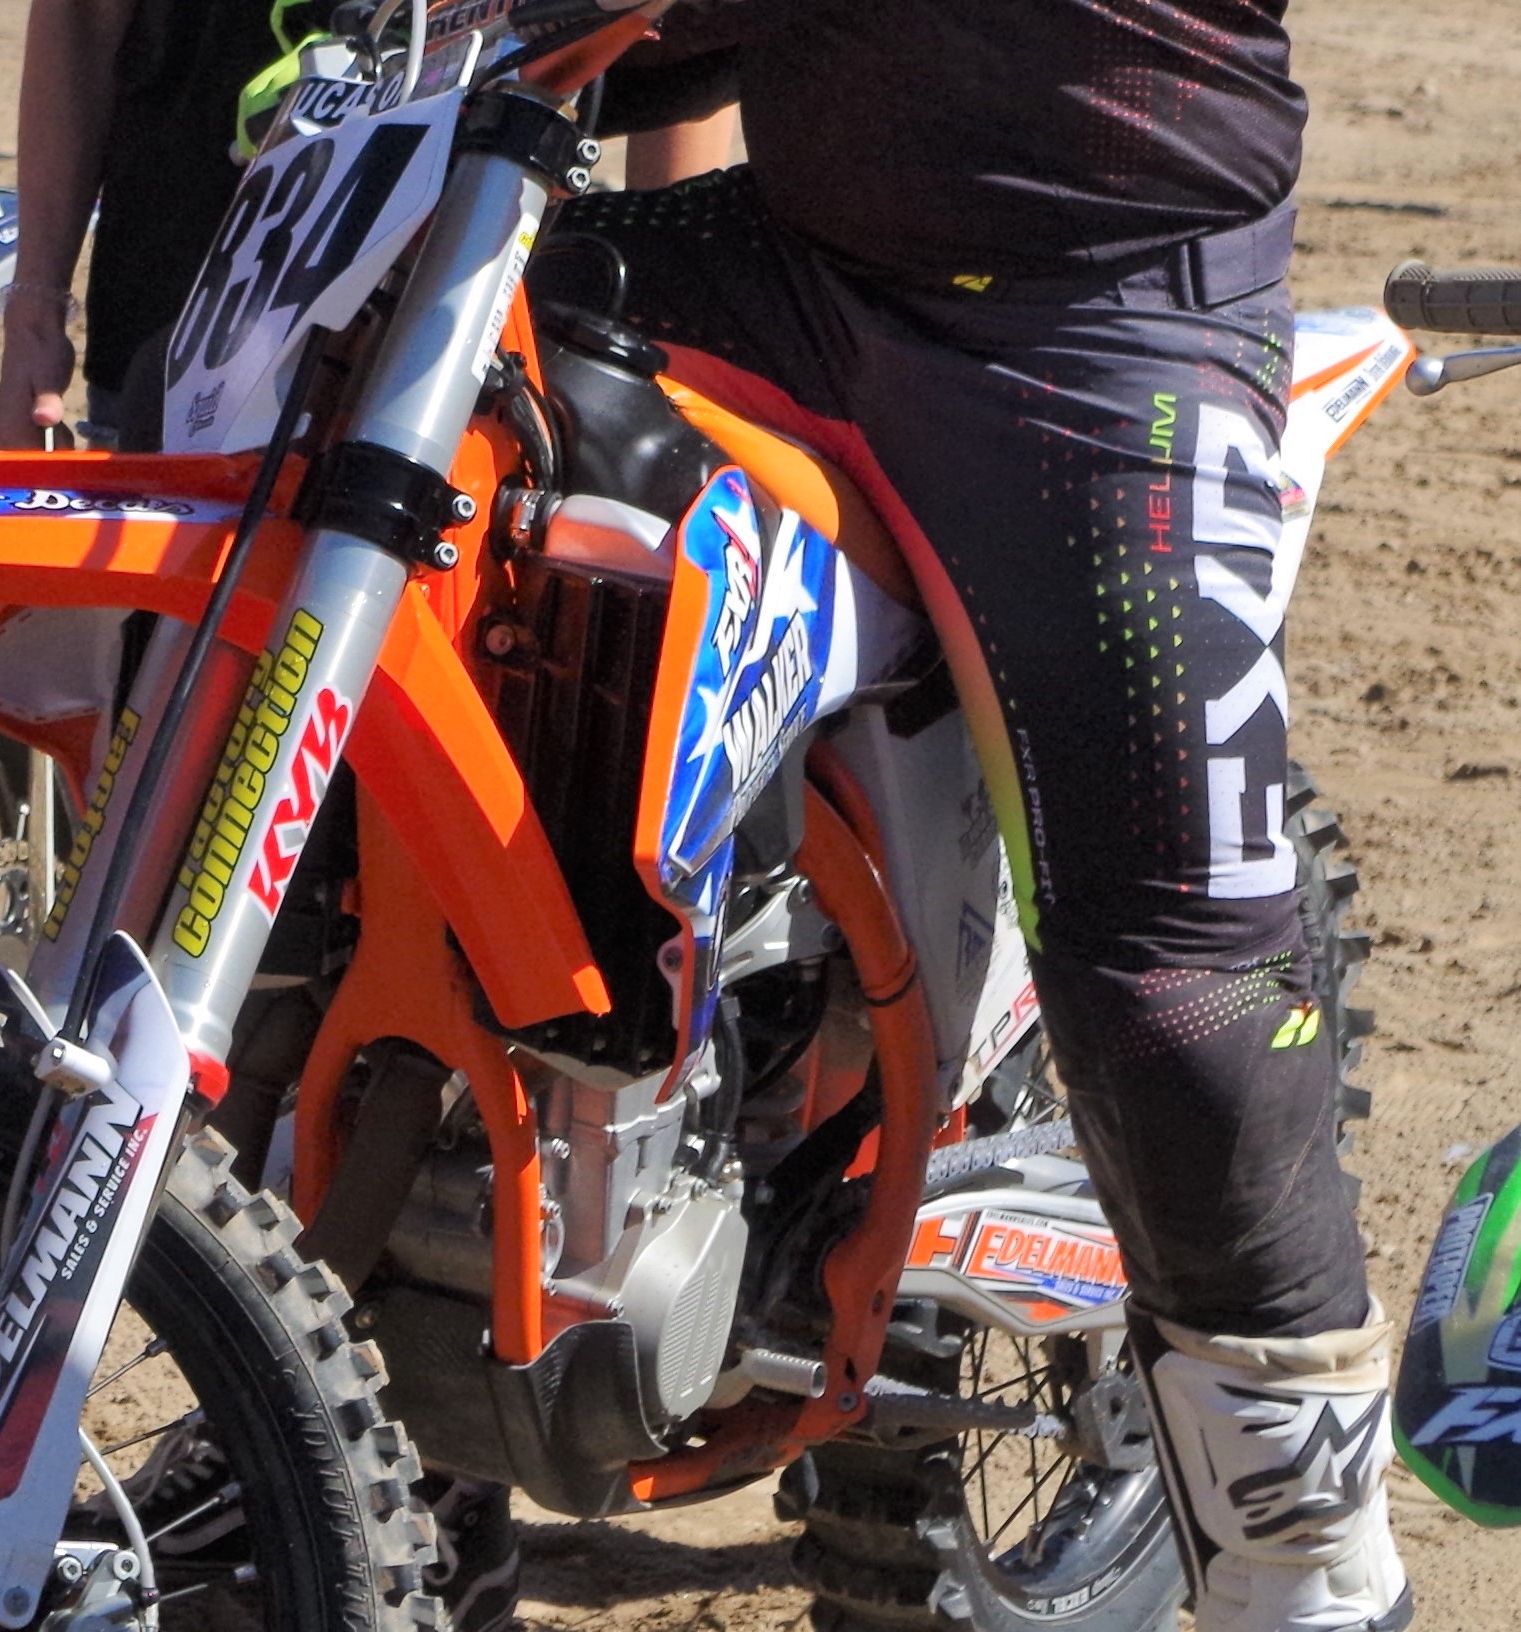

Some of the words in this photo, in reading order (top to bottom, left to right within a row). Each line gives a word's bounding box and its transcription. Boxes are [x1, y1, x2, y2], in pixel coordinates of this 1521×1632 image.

[169, 123, 432, 378] 834
[1191, 402, 1298, 901] FXR
[246, 686, 354, 929] KYB
[61, 1235, 91, 1281] SALES
[85, 1217, 99, 1235] &
[93, 1154, 131, 1220] SERVICE
[123, 1126, 149, 1160] INC.
